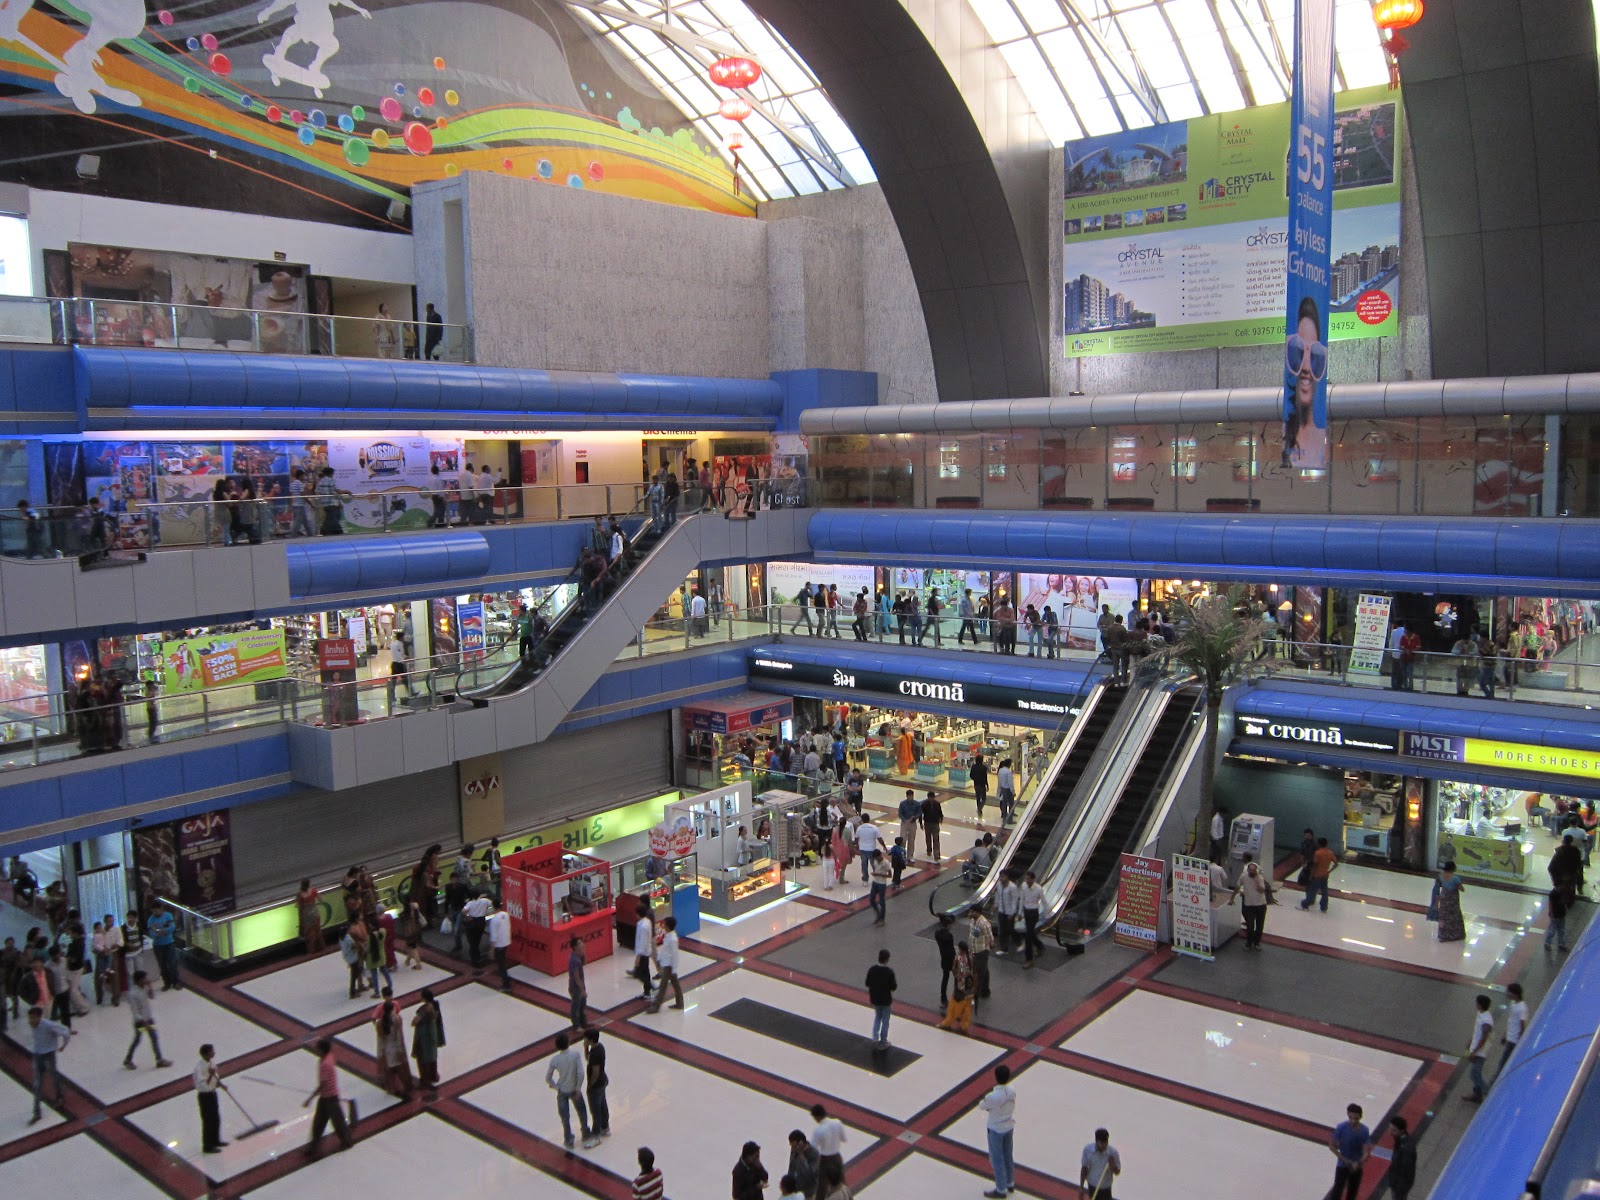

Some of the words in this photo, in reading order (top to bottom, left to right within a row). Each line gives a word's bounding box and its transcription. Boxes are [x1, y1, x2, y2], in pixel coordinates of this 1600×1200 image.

[1226, 137, 1247, 145] MALL
[1298, 124, 1325, 191] 55
[1226, 171, 1275, 186] CRYSTAL
[1226, 184, 1251, 195] CITY
[1089, 199, 1109, 208] ACRES
[1112, 194, 1148, 204] TOWNSHIP
[1150, 189, 1179, 199] PROJECT
[1247, 232, 1288, 247] CRYST
[1309, 226, 1326, 254] less
[1118, 248, 1164, 262] CRYSTAL
[1120, 259, 1163, 268] AVENUE
[1288, 250, 1304, 278] Gt
[1235, 328, 1250, 337] Cell:
[1252, 326, 1275, 336] 93757
[1331, 322, 1356, 331] 94752
[367, 445, 400, 458] MISSION
[251, 633, 282, 641] Anniversary
[247, 641, 278, 649] Celebration
[210, 653, 235, 667] 50%
[212, 662, 237, 675] CASH
[213, 669, 238, 682] BACK
[1017, 700, 1029, 709] The
[1030, 701, 1064, 713] Electronics
[1410, 734, 1457, 754] MSL
[1410, 750, 1458, 760] FOOTWEAR
[1494, 750, 1533, 763] MORE
[1540, 755, 1588, 769] SHOES
[182, 812, 224, 837] GAJA
[1135, 858, 1149, 868] Jay
[1121, 865, 1162, 879] Advertising
[1174, 871, 1184, 880] FREE
[1187, 874, 1196, 882] FREE
[1199, 876, 1209, 885] FREE
